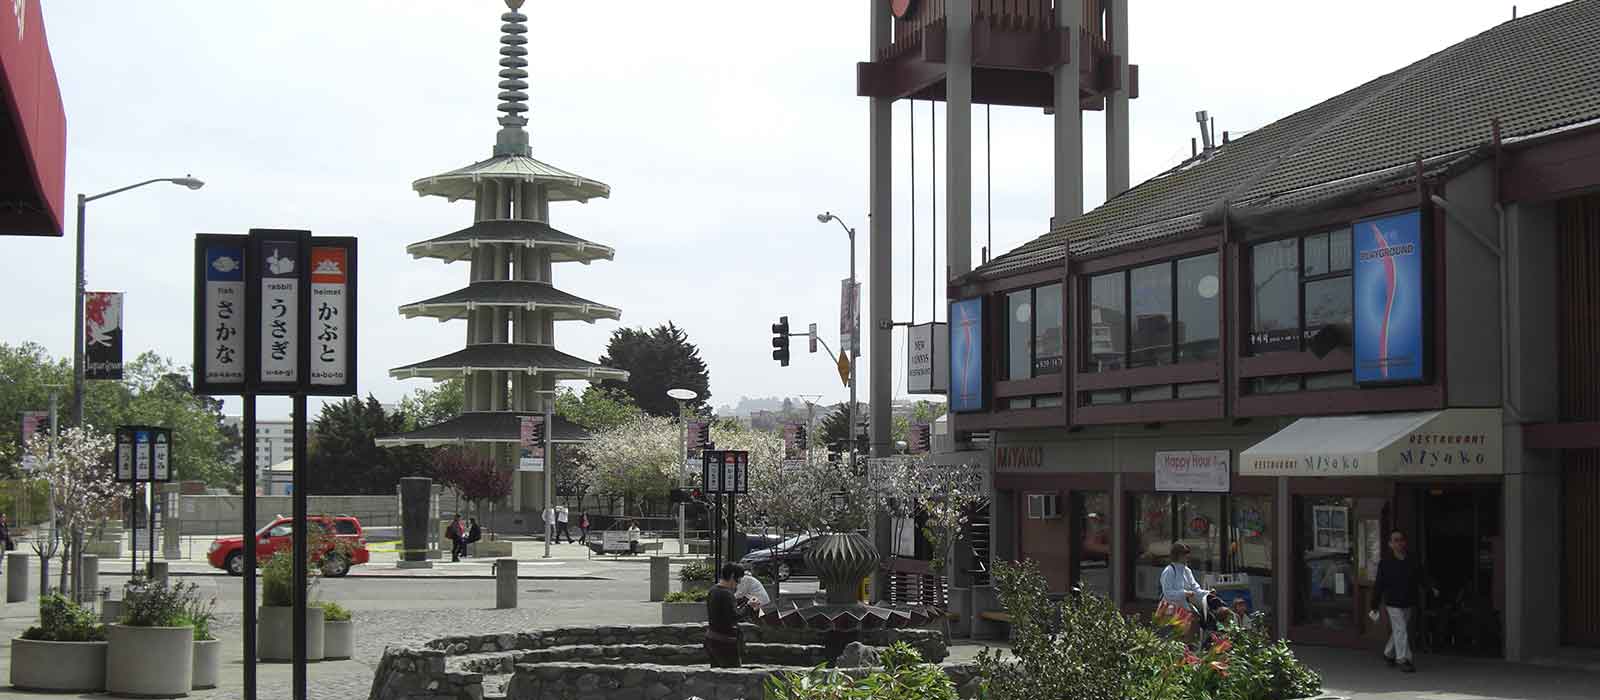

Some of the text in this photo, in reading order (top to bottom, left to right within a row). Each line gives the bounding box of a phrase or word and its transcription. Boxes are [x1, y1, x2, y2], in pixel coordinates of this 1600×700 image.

[217, 287, 235, 295] fish
[267, 283, 292, 291] rabbit
[313, 288, 342, 296] helmet
[215, 300, 237, 364] さかな
[271, 298, 290, 361] うさぎ
[317, 302, 338, 363] かぶと
[1409, 433, 1487, 445] RESTAURANT
[996, 447, 1042, 468] MIYAKO
[1164, 455, 1191, 470] Happy
[1192, 455, 1211, 467] Hour
